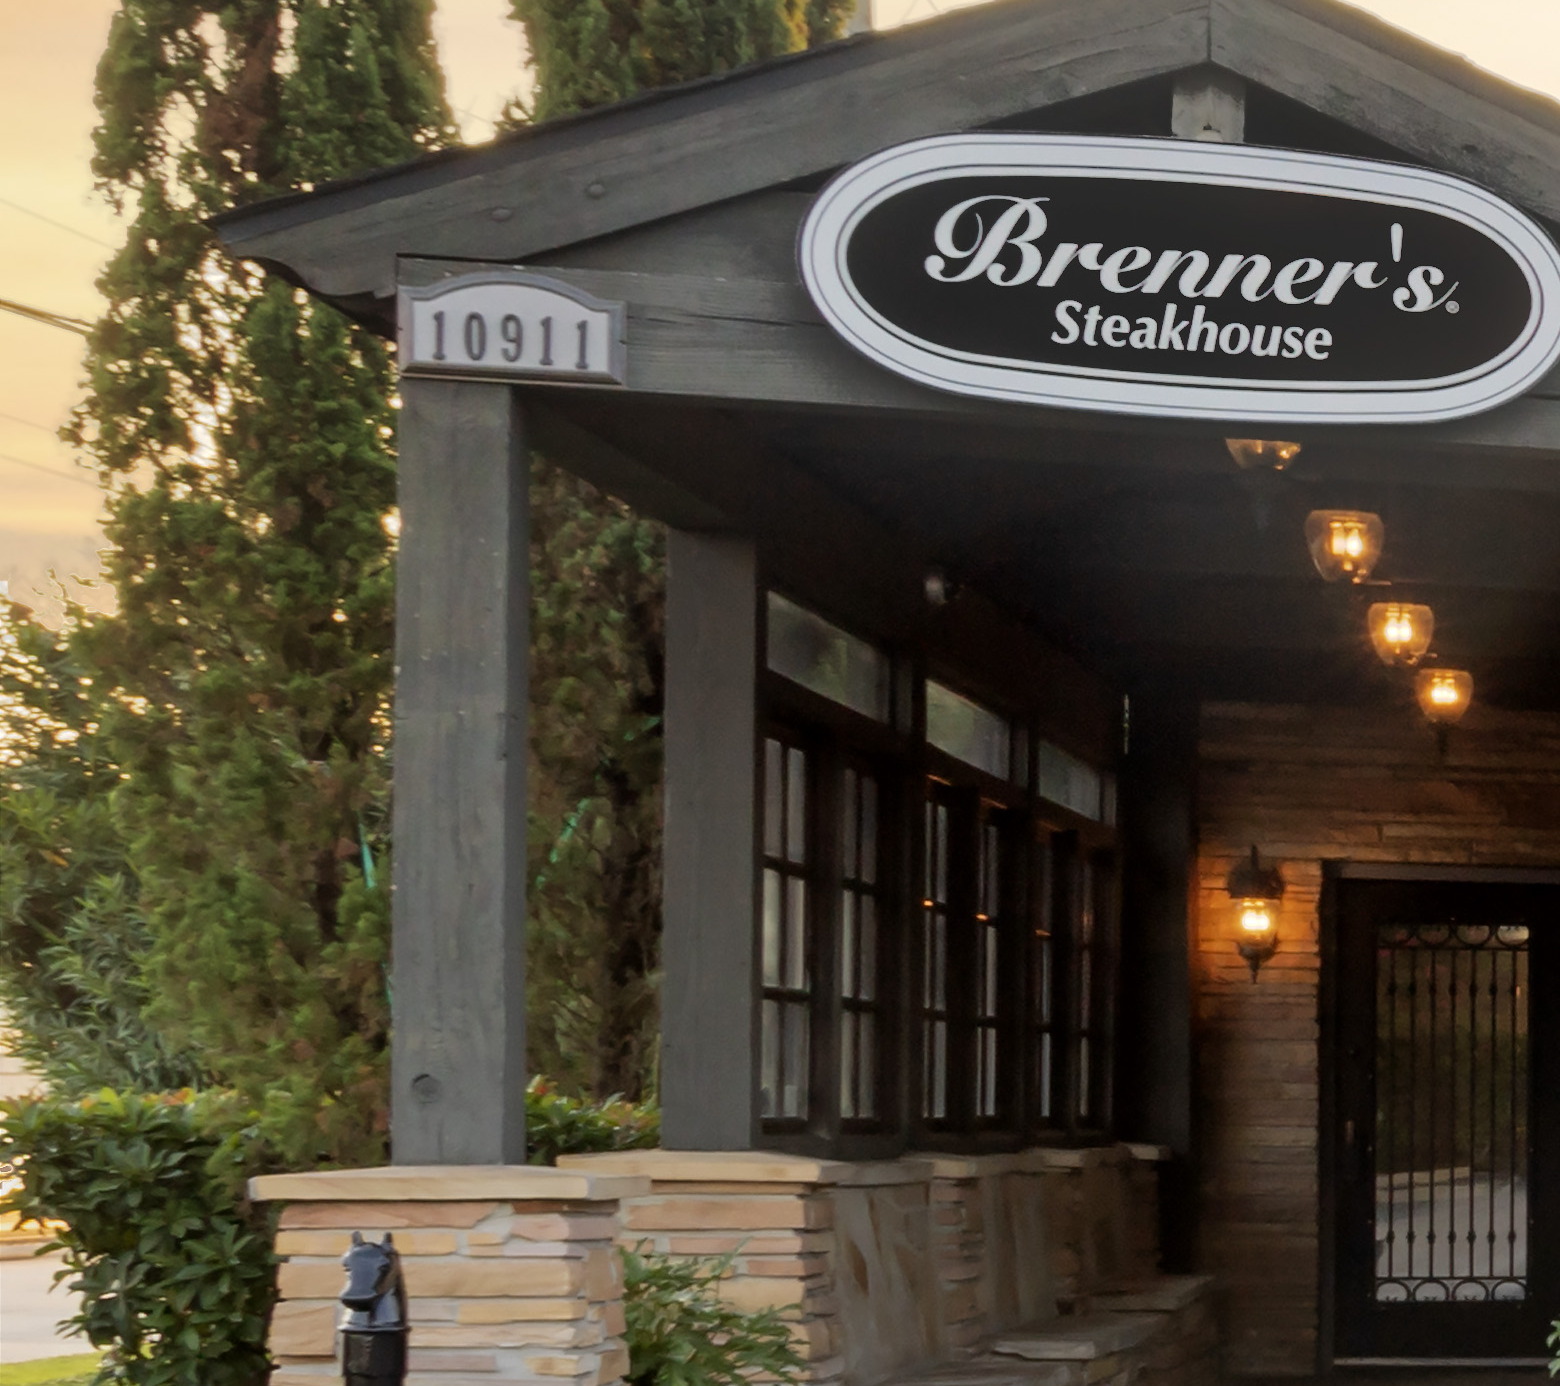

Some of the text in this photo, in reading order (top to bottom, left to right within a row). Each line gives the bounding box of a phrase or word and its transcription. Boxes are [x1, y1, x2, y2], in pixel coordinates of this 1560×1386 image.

[924, 194, 1460, 314] Brenner's
[432, 310, 589, 370] 10911
[1050, 299, 1333, 361] Steakhouse
